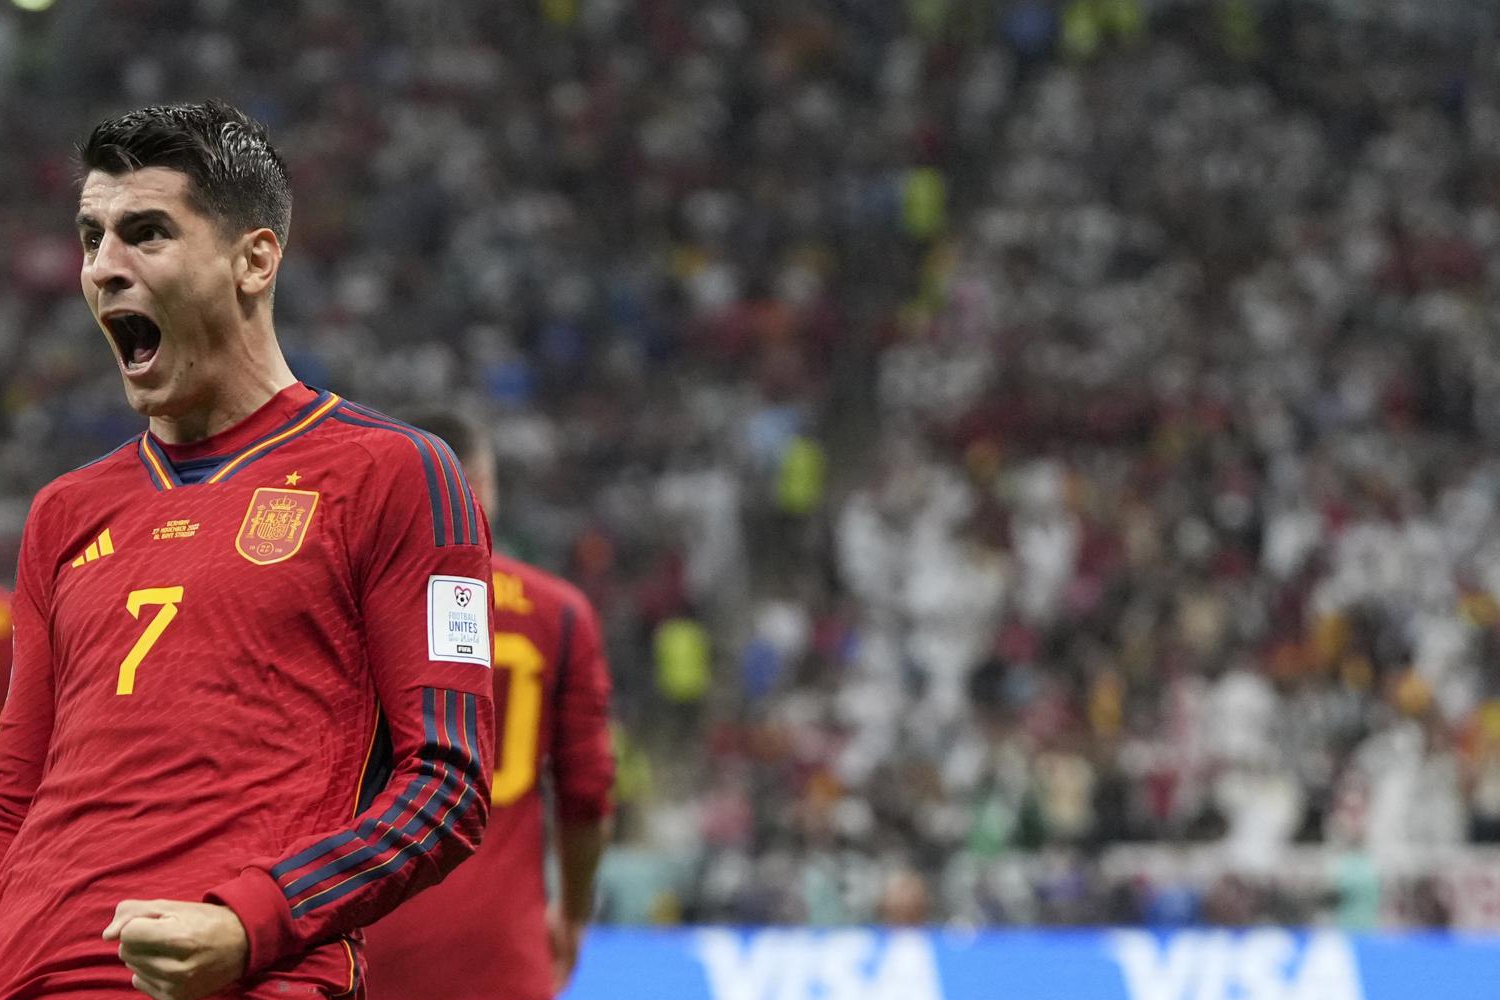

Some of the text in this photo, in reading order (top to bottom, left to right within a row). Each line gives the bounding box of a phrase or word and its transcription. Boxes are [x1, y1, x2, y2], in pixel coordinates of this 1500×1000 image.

[448, 611, 476, 622] FOOTBALL
[448, 621, 478, 634] UNITES
[116, 586, 184, 695] 7
